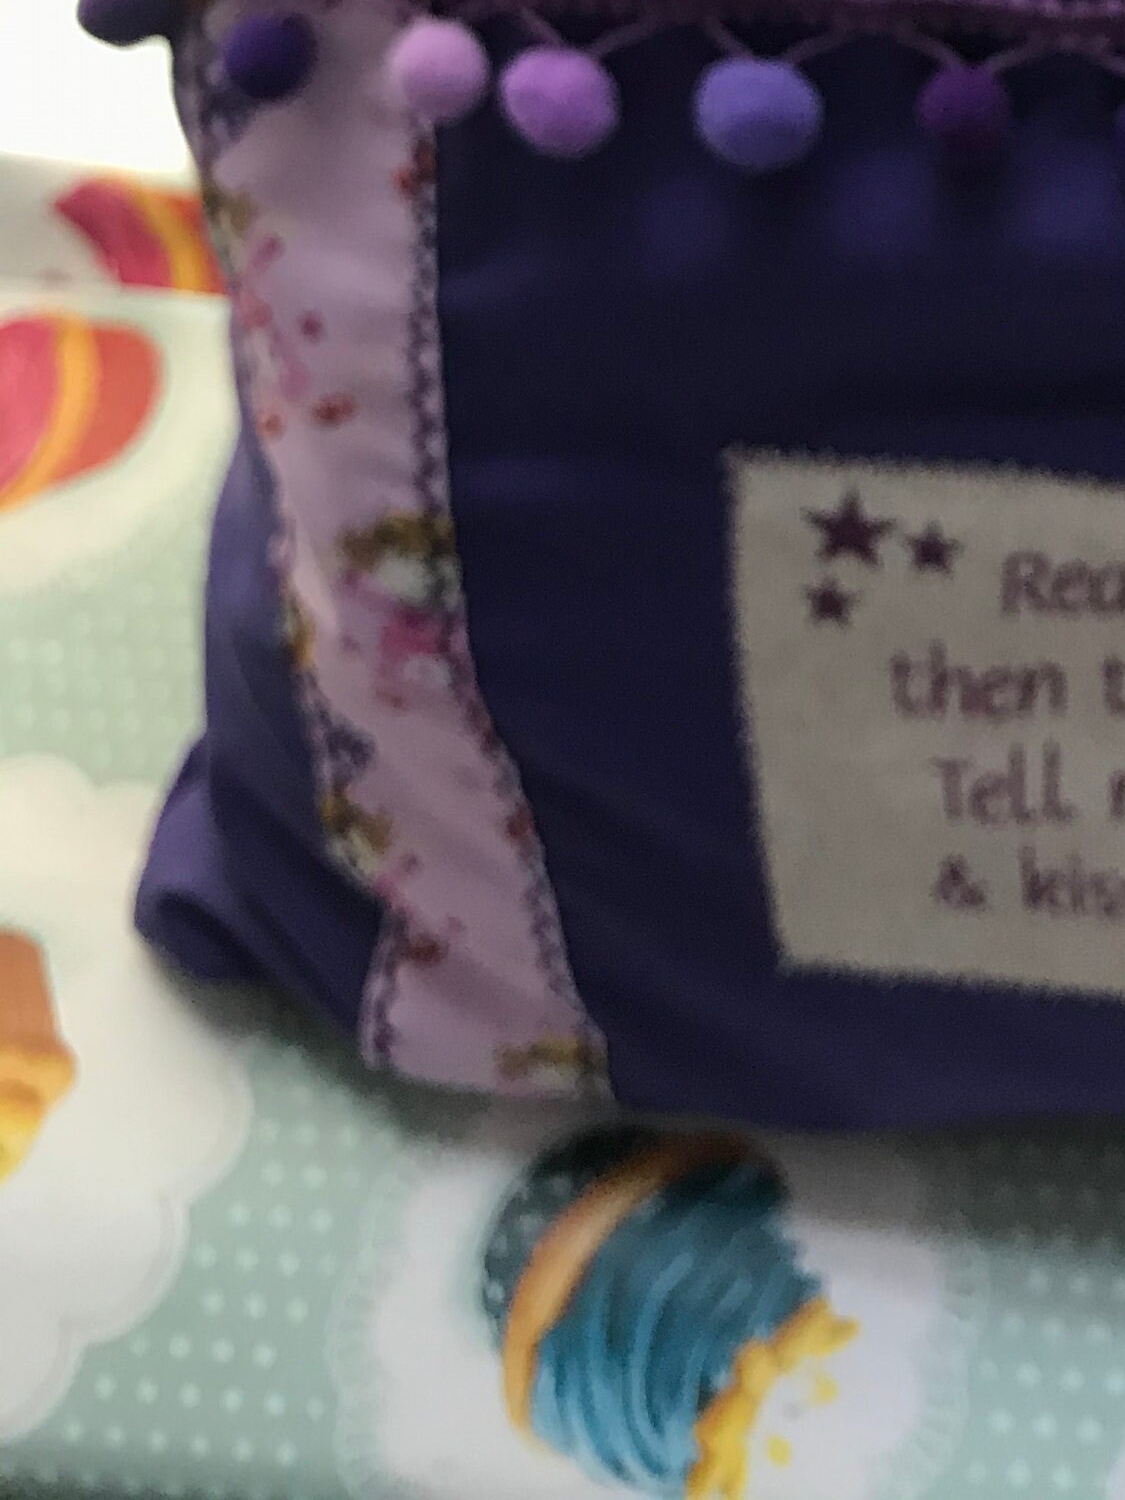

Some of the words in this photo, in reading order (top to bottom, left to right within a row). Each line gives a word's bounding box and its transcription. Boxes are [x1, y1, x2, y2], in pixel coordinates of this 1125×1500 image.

[890, 640, 1068, 722] then
[930, 740, 1076, 825] Tell
[930, 853, 988, 912] &
